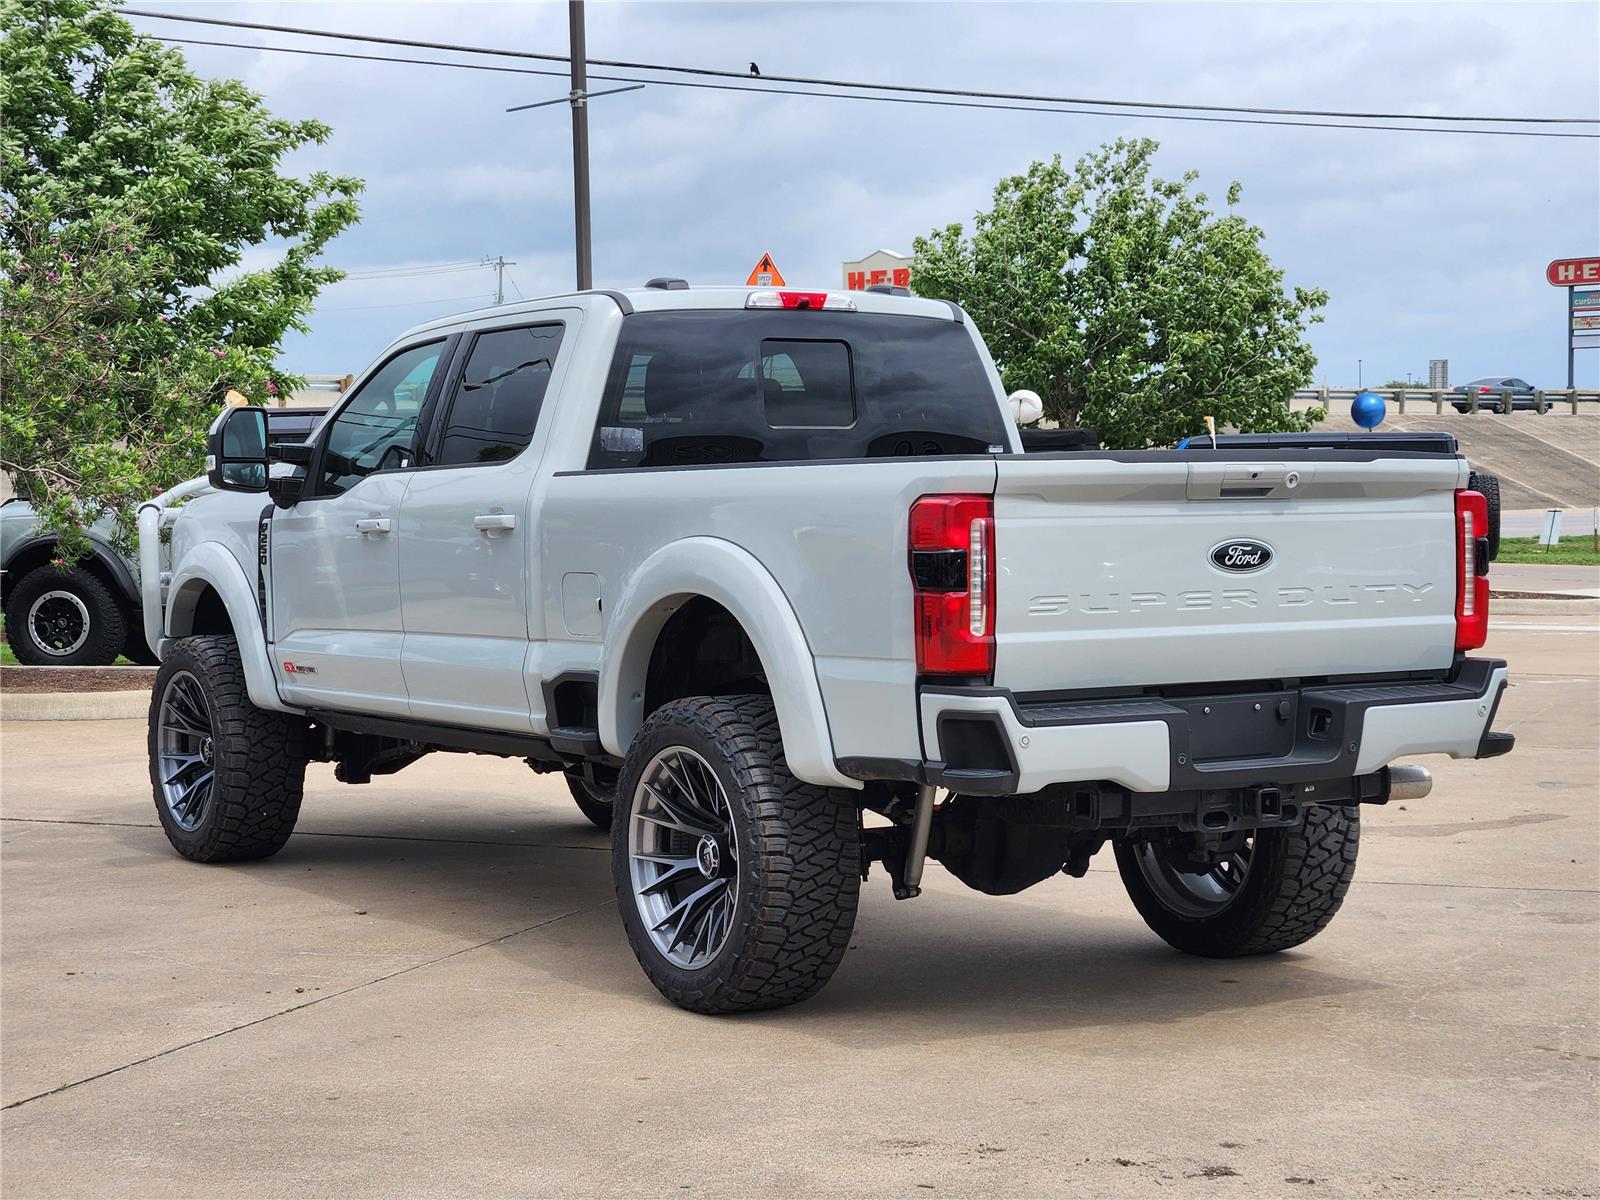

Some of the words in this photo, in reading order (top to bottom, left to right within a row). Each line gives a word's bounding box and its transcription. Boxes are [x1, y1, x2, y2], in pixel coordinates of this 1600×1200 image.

[1225, 545, 1261, 566] Ford
[1028, 588, 1257, 617] SUPER
[1277, 582, 1433, 607] DUTY
